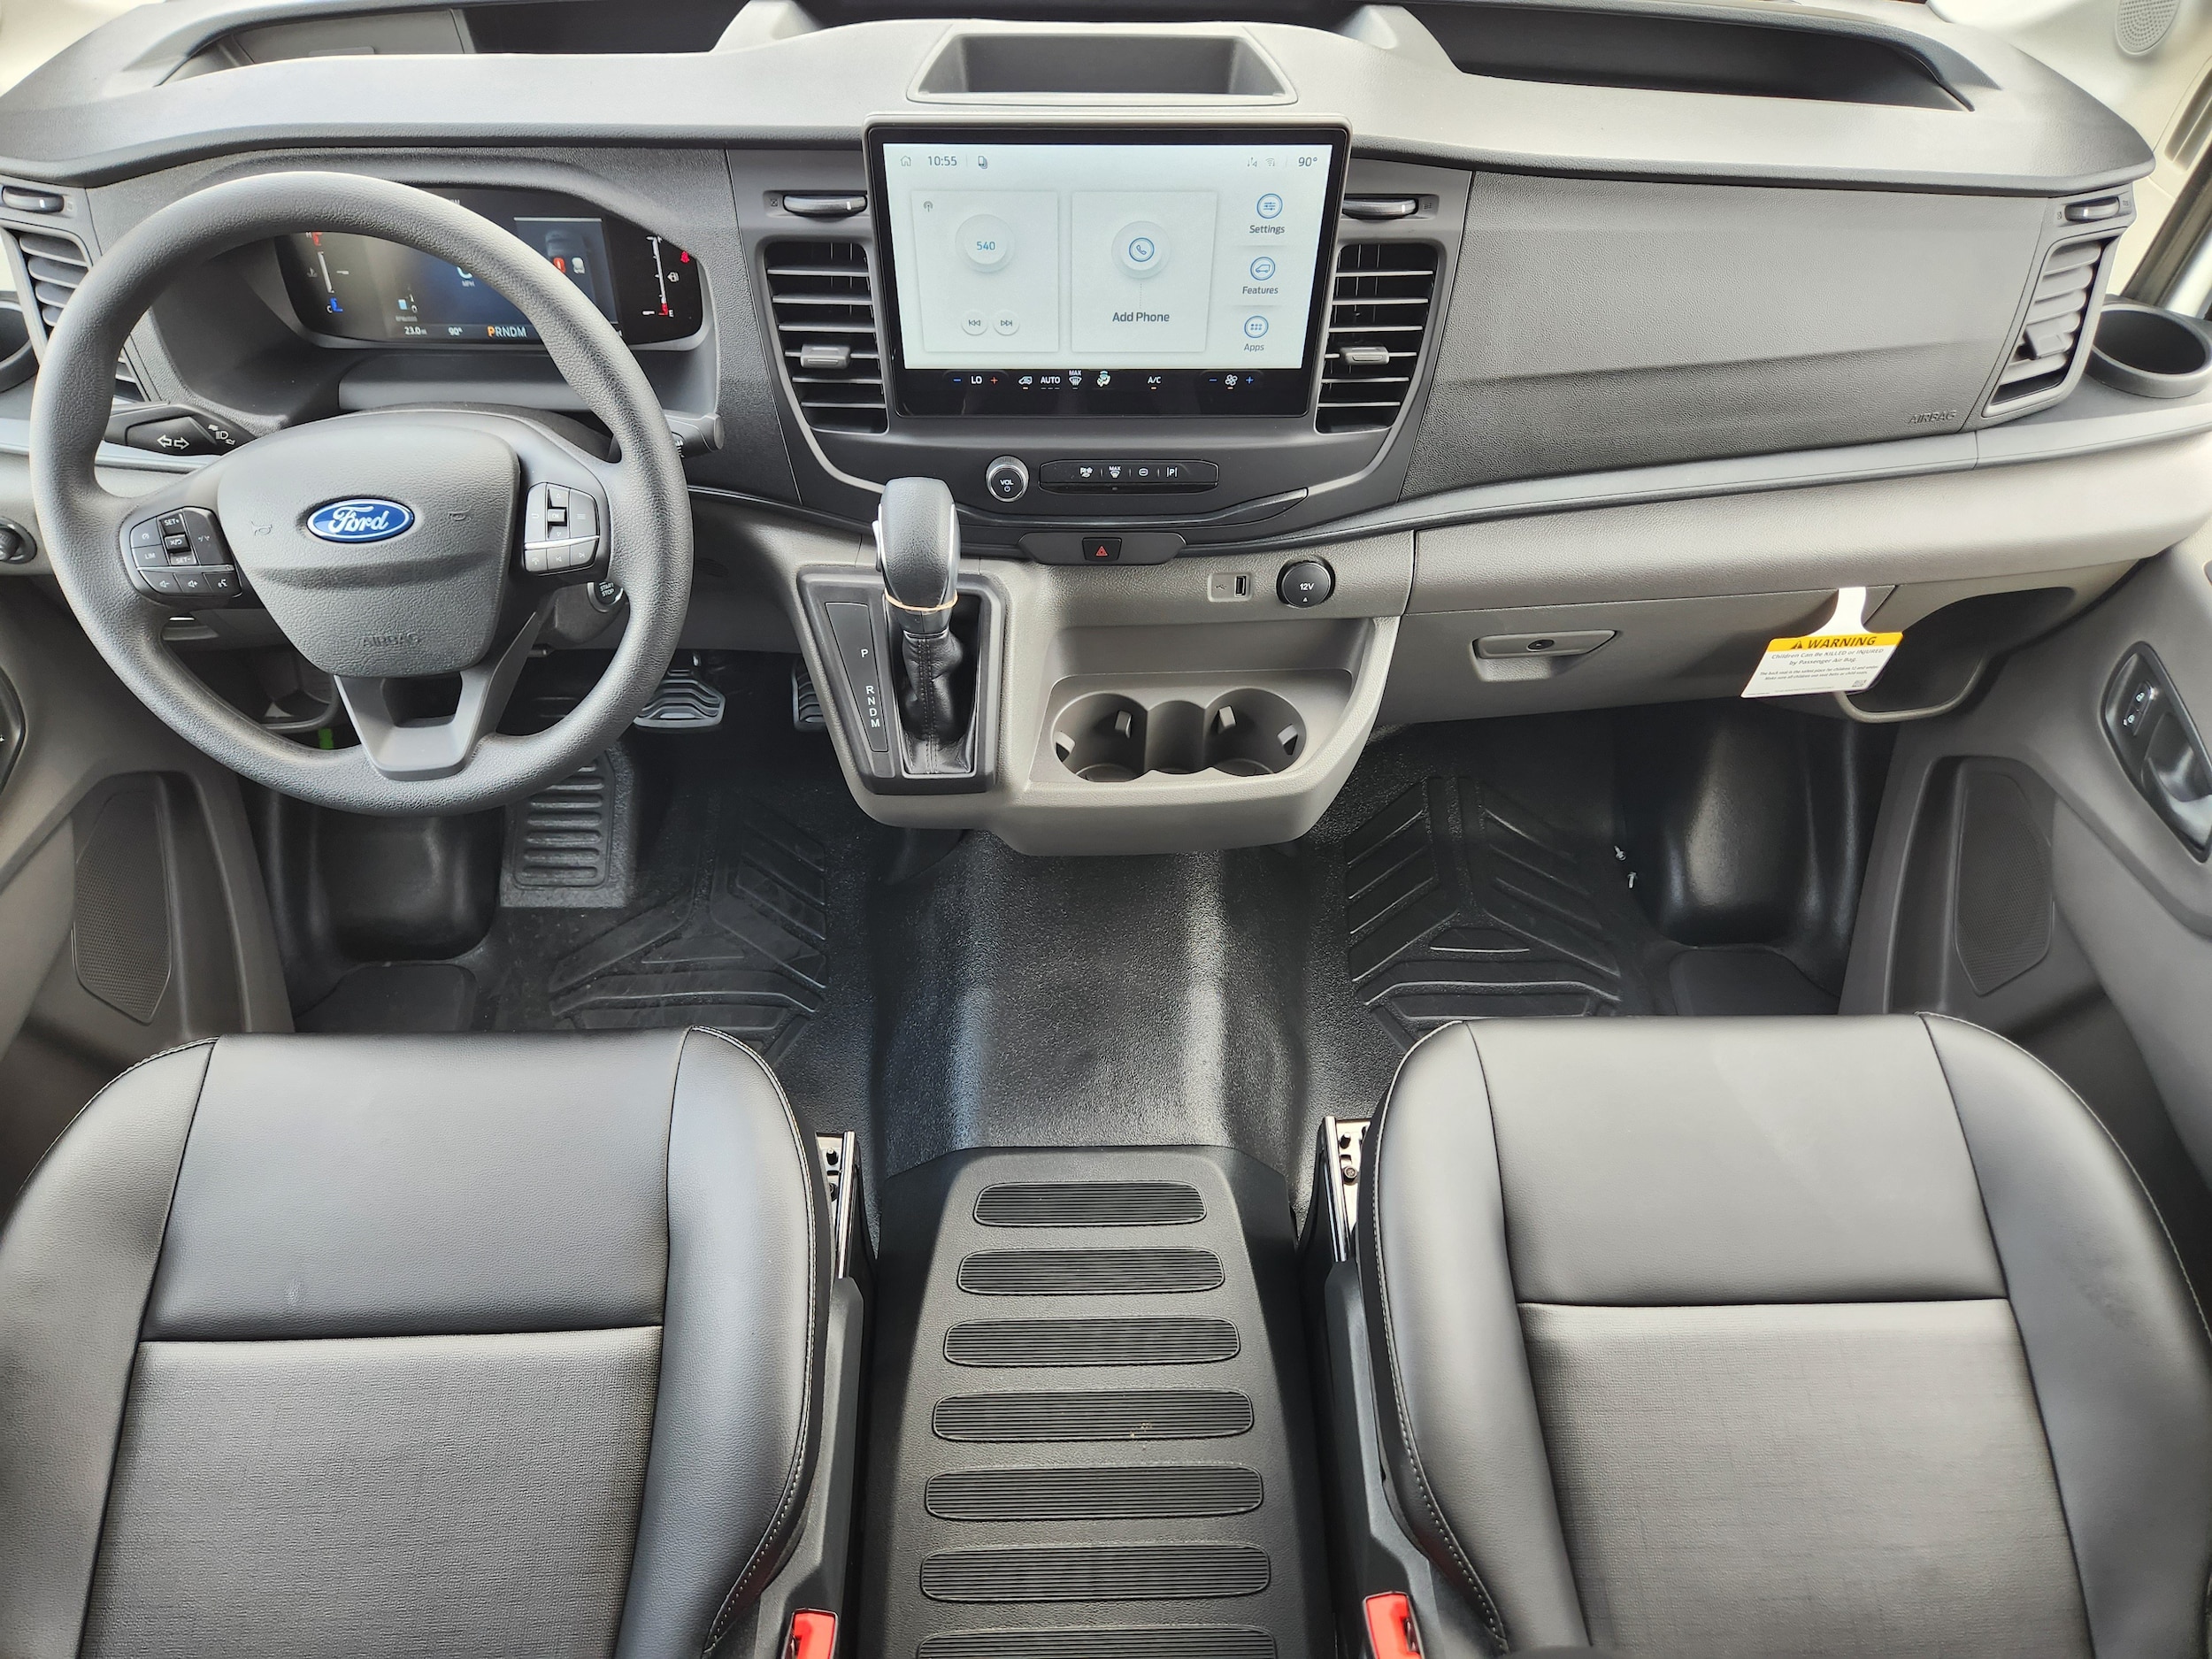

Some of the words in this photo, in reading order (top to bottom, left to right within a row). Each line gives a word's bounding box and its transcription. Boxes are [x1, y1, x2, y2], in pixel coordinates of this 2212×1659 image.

[927, 156, 957, 166] 10:55
[1298, 157, 1318, 167] 90°
[1249, 225, 1286, 234] Settings
[976, 241, 996, 250] 540
[1241, 286, 1279, 295] Features
[1112, 311, 1134, 322] Add
[1135, 311, 1170, 322] Phone
[1243, 343, 1264, 352] Apps
[971, 376, 983, 385] LO
[1040, 376, 1061, 385] AUTO
[1908, 410, 1957, 425] AIRBAG
[328, 505, 390, 534] Ford
[1300, 582, 1315, 591] 12V
[1808, 636, 1878, 649] WARNING
[861, 649, 868, 657] P
[866, 685, 875, 695] R
[867, 696, 876, 705] N
[869, 708, 878, 717] D
[871, 718, 880, 727] M
